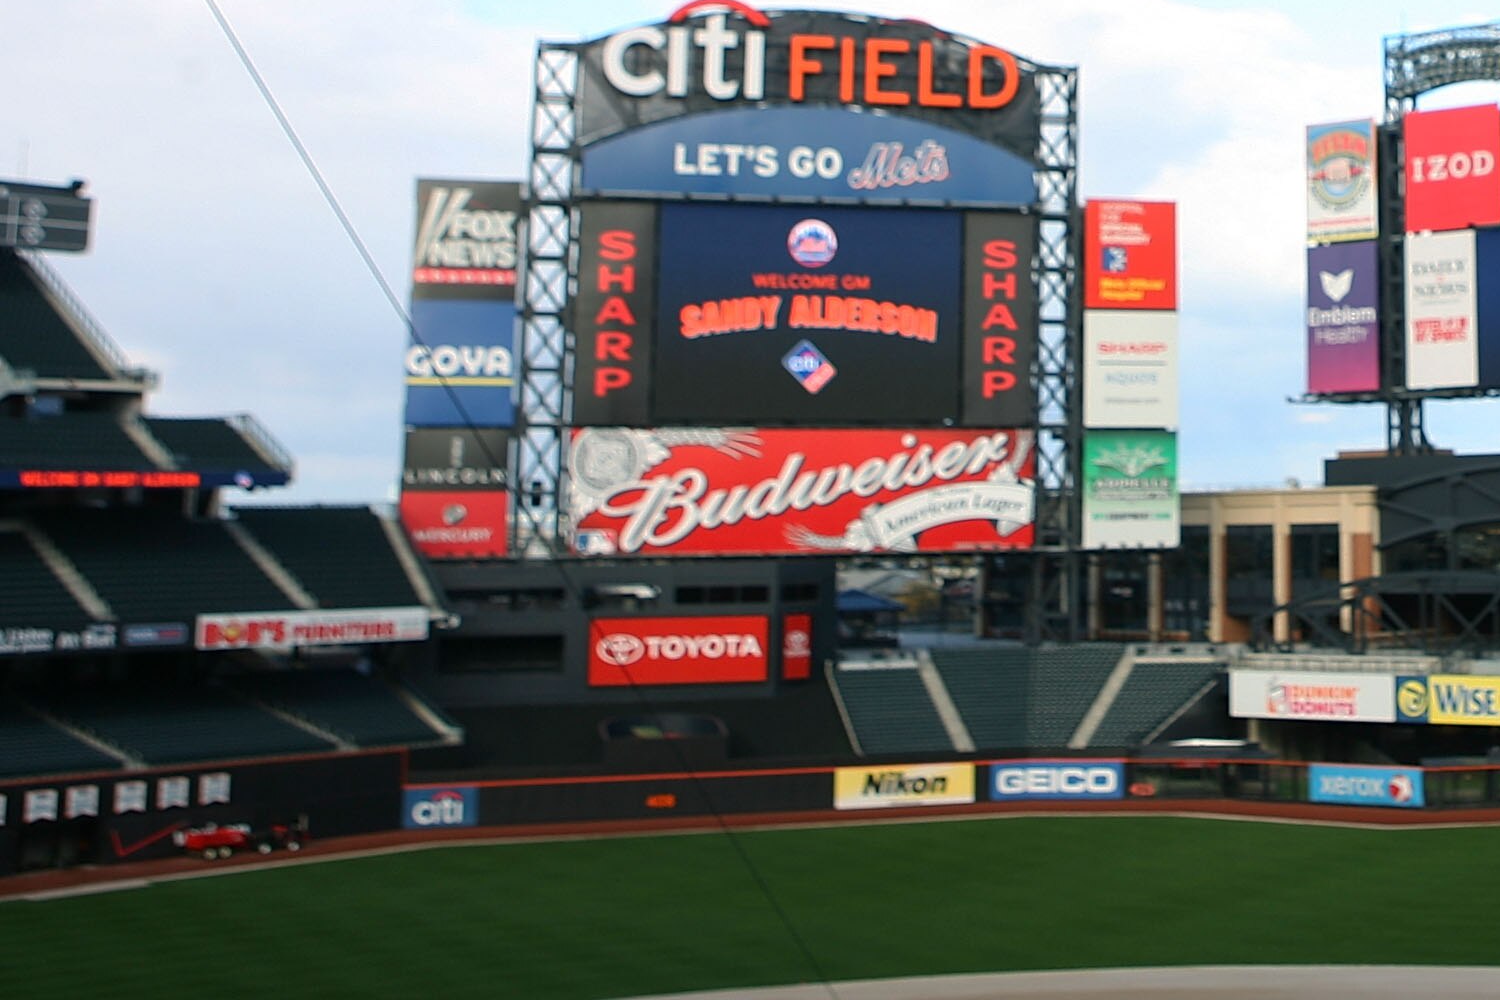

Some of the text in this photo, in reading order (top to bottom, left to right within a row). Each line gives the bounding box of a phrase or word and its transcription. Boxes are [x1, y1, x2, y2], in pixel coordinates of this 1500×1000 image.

[602, 3, 1020, 110] citi FIELD
[673, 139, 951, 190] LET'S GO Mets
[1411, 149, 1495, 183] IZOD
[448, 208, 516, 240] FOX
[427, 239, 516, 269] NEWS
[752, 273, 871, 290] WELCOME GM
[594, 229, 637, 398] SHARP
[679, 294, 938, 343] SANDY ALDERSON
[981, 239, 1019, 399] SHARP
[1308, 305, 1377, 327] Emblem
[405, 344, 513, 377] GOYA
[404, 467, 508, 485] LINCOLN
[604, 432, 1009, 553] Budweiser
[643, 633, 763, 659] TOYOTA
[860, 772, 948, 796] Nikon
[995, 766, 1119, 795] GEICO
[1319, 773, 1386, 797] xerox
[411, 796, 464, 826] citi
